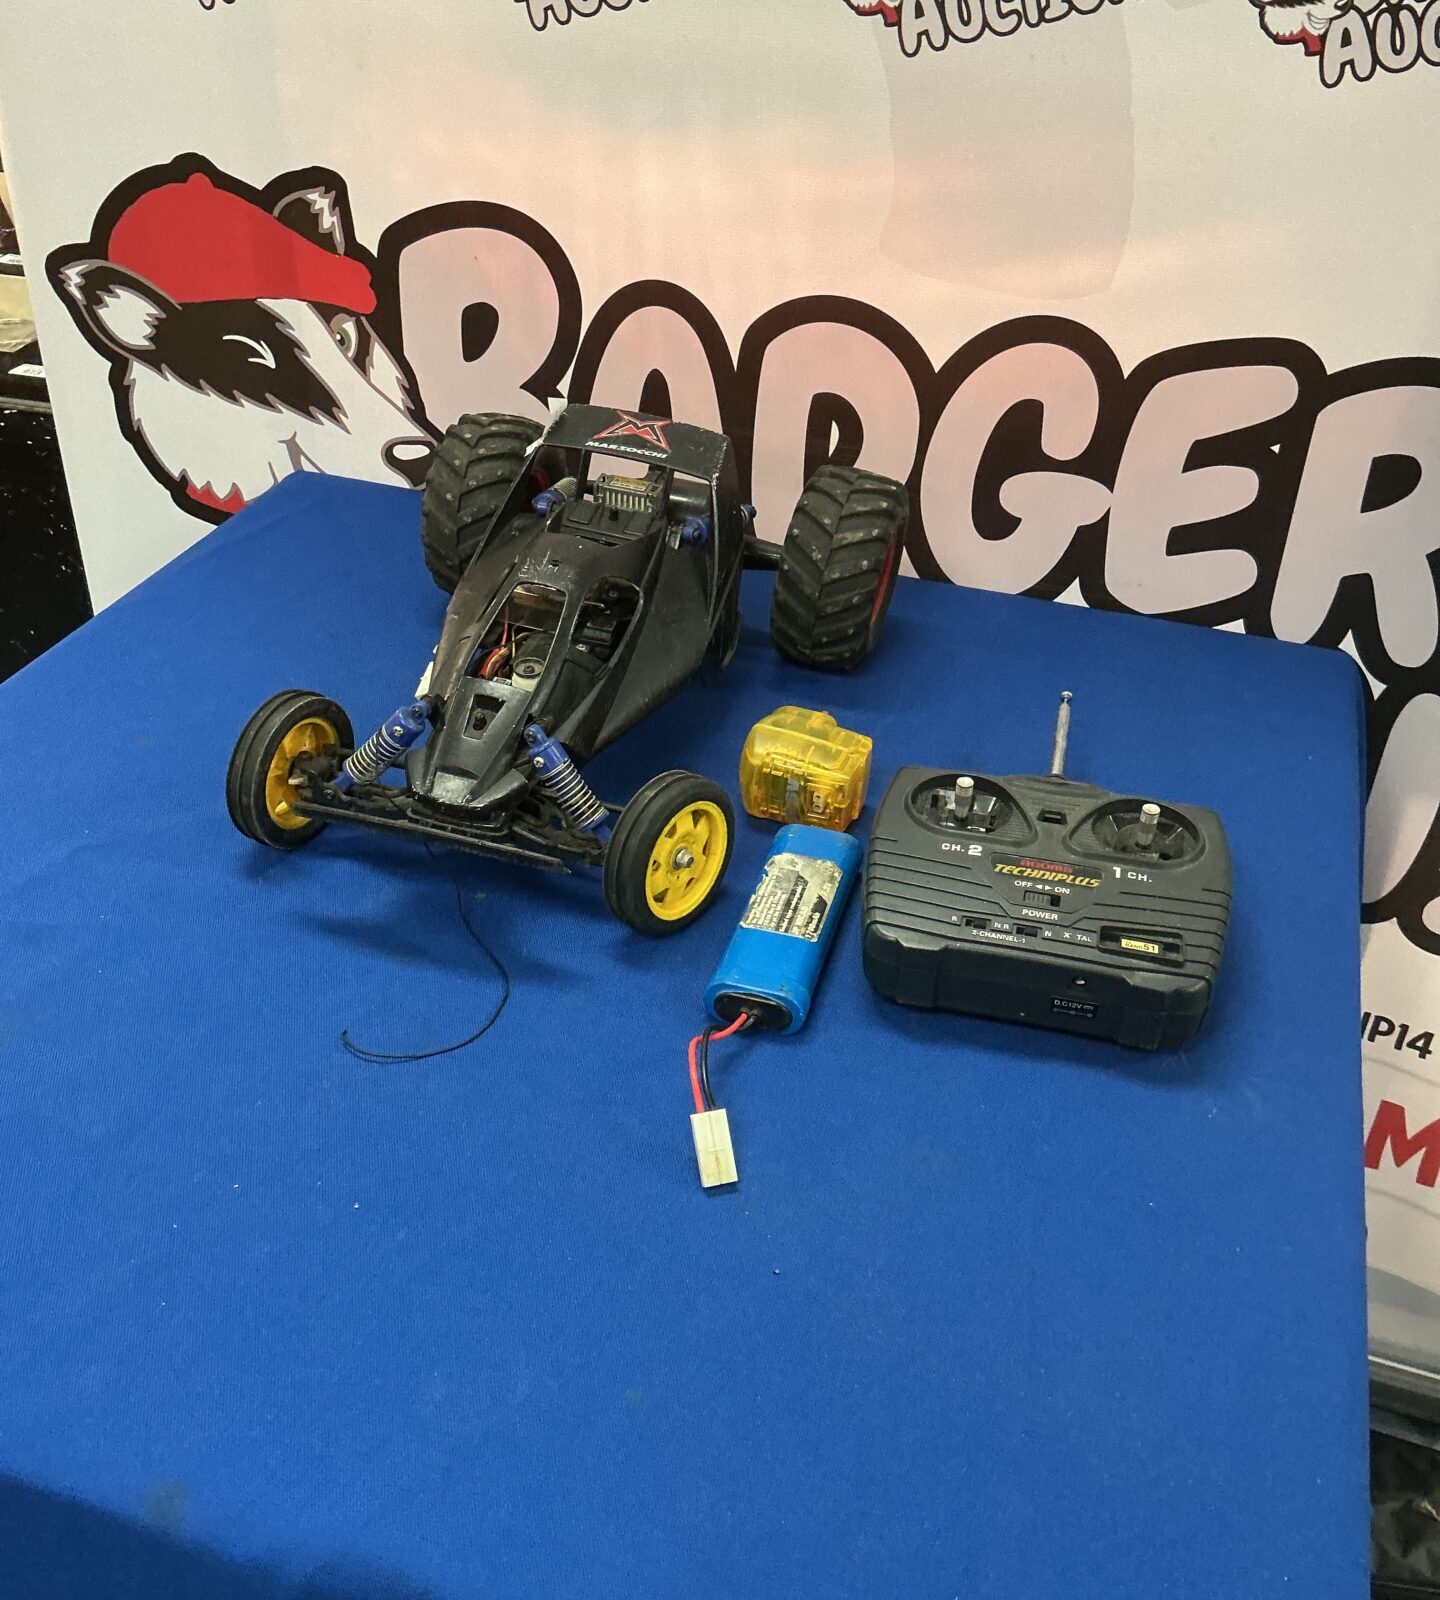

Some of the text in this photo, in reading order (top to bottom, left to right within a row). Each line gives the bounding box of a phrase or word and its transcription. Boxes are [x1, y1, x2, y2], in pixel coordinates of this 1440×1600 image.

[585, 441, 668, 459] MARZOCCHI
[942, 842, 983, 856] CH. 2
[993, 863, 1102, 888] TECHNIPLUS
[1112, 866, 1153, 883] 1 CH.
[1014, 880, 1071, 895] OFF ON
[1022, 908, 1059, 921] POWER
